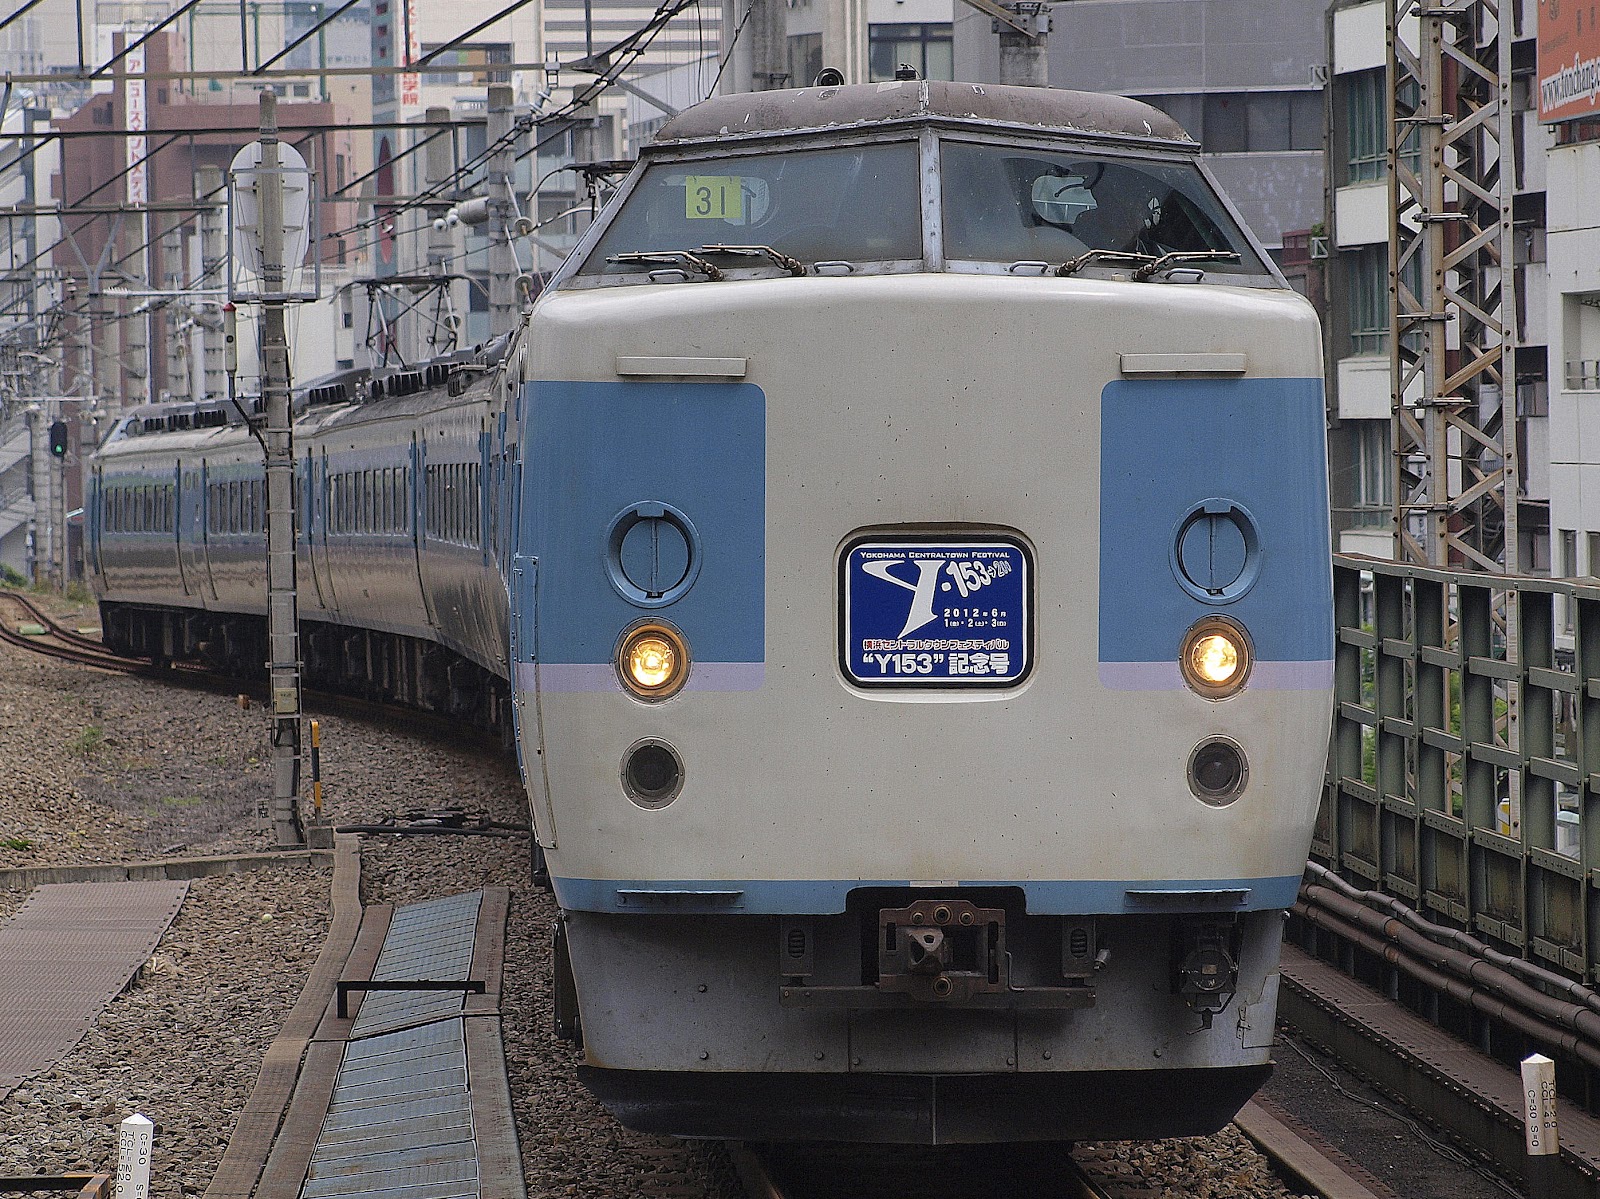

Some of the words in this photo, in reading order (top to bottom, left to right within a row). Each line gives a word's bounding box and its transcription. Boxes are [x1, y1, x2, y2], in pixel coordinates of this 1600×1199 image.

[696, 186, 725, 215] 31
[860, 551, 906, 559] YOKOHAMA
[908, 551, 969, 559] CENTRALTOWN
[971, 551, 1010, 559] FESTIVAL
[948, 652, 1010, 675] 記念号
